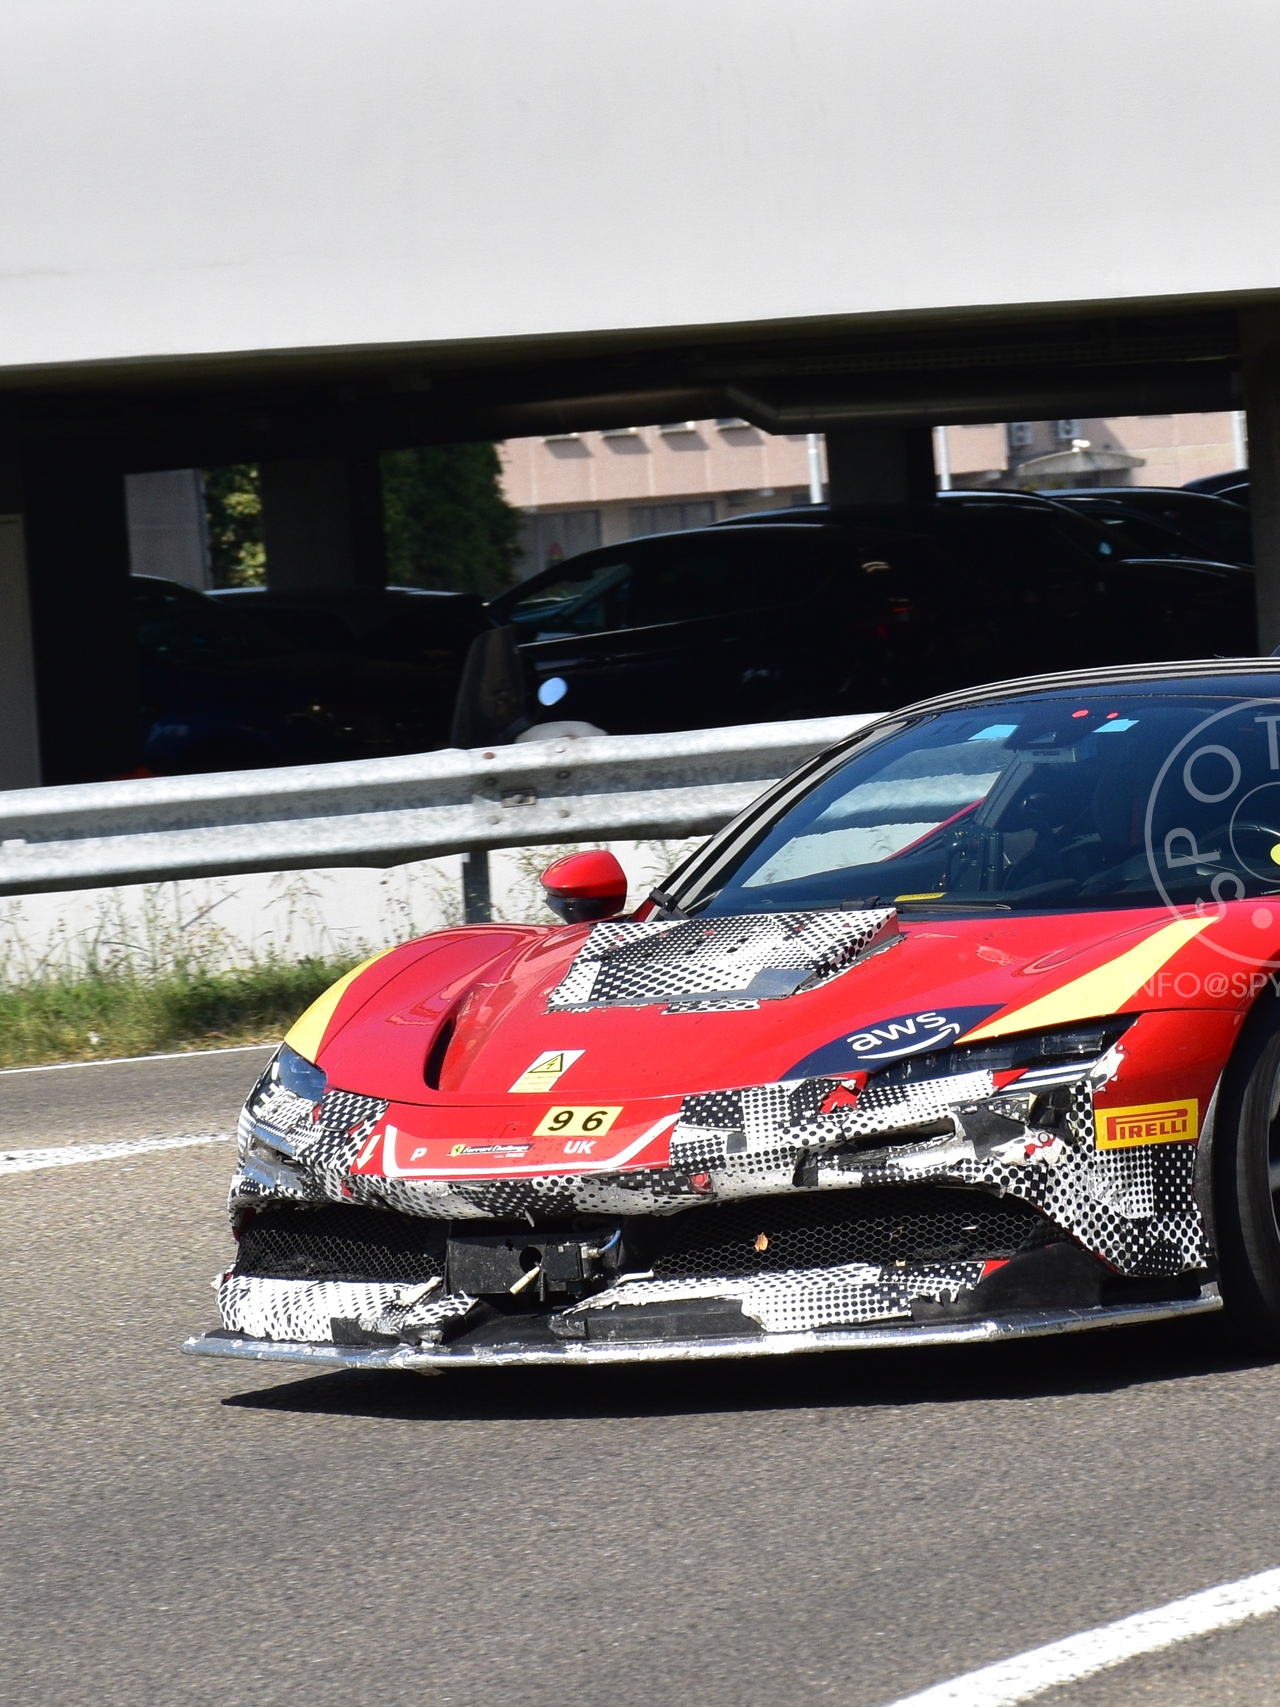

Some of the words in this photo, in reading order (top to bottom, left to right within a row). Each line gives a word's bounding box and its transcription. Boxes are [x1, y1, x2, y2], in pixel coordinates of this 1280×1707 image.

[846, 1012, 947, 1051] aws
[1106, 1108, 1188, 1141] PIRELLI
[563, 1141, 596, 1154] UK
